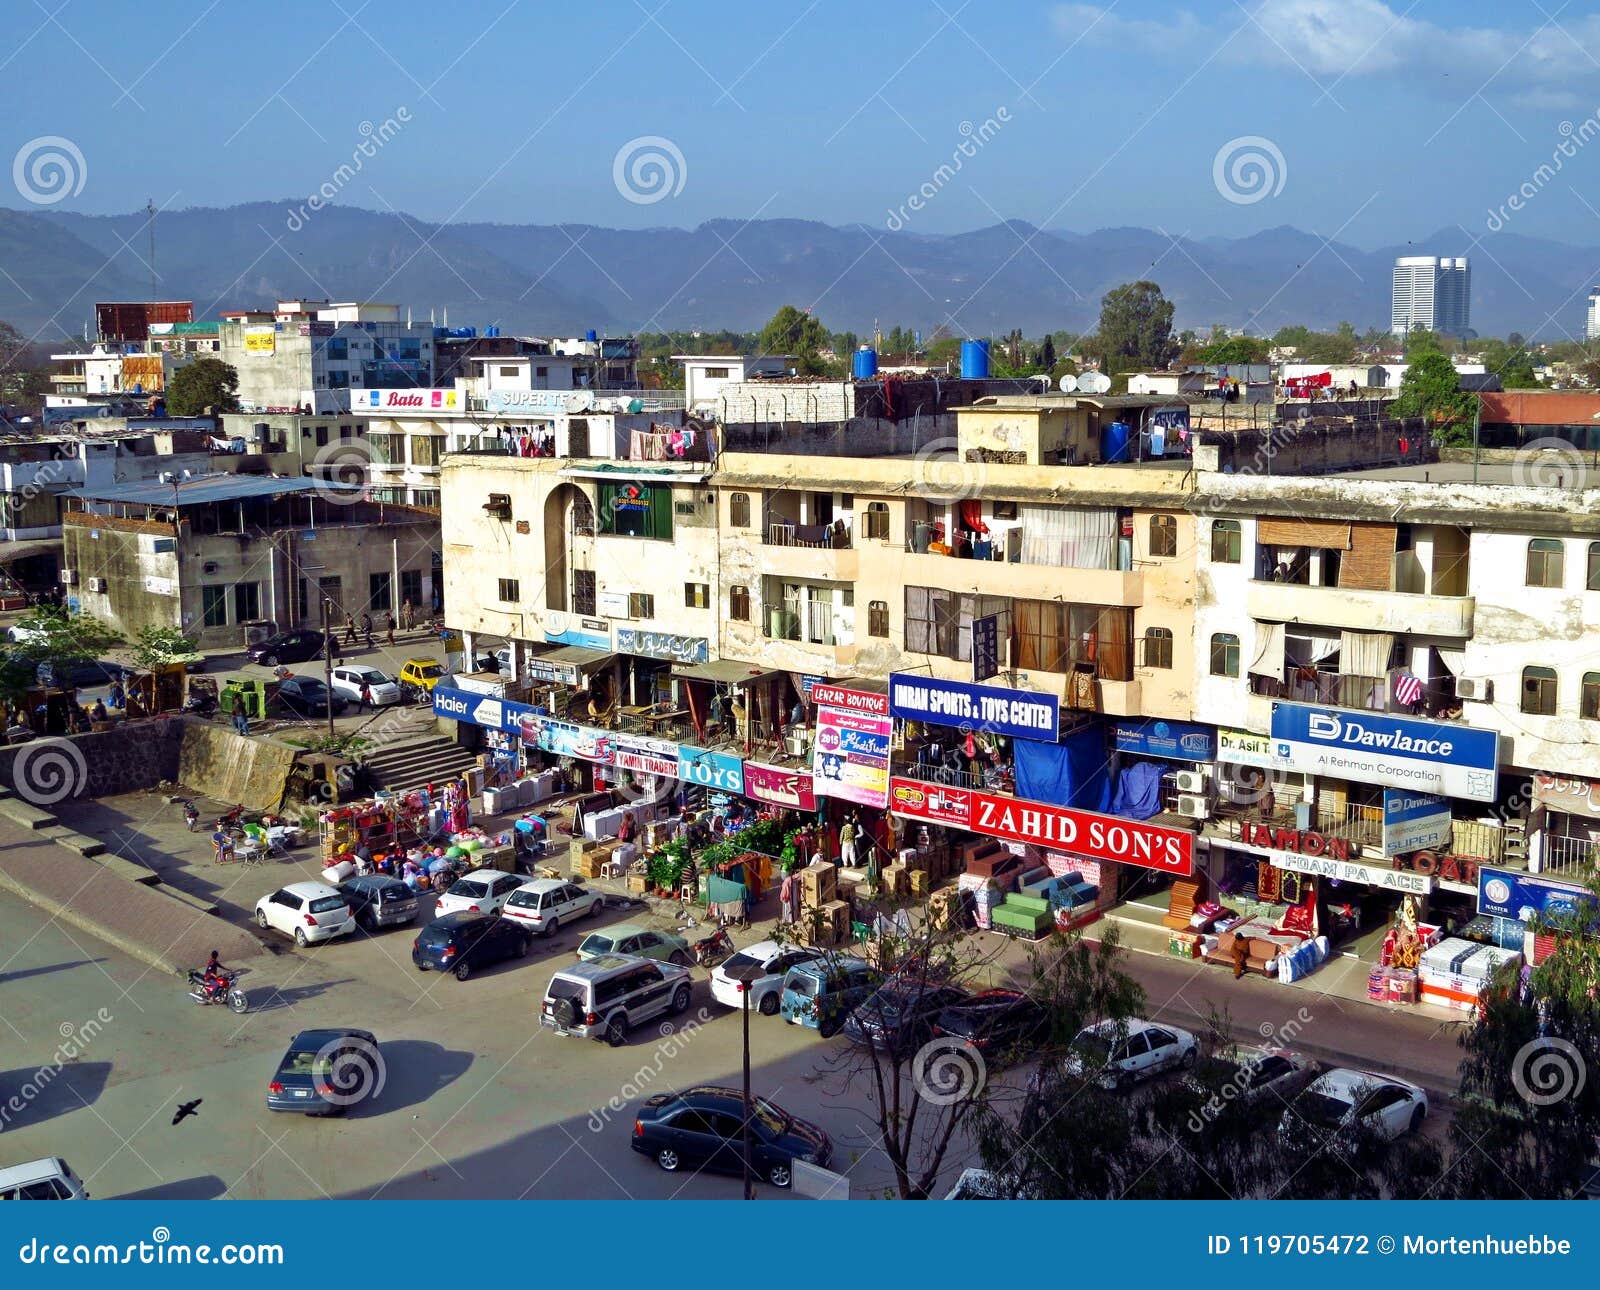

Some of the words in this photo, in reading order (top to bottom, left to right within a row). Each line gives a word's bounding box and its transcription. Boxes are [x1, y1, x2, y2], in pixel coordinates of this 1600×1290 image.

[386, 391, 424, 407] Bata
[503, 392, 547, 407] SUPER
[435, 693, 467, 714] Haier
[847, 693, 884, 711] BOUTIQUE
[895, 684, 928, 711] IMRAN
[930, 689, 972, 718] SPORTS
[973, 704, 979, 719] &
[980, 696, 1009, 724] TOYS
[1010, 700, 1053, 730] CENTER
[821, 733, 839, 744] 2015
[1221, 736, 1235, 749] Dr.
[1238, 739, 1259, 753] Asif
[1343, 722, 1453, 757] Dawlance
[619, 753, 643, 770] YAMIN
[645, 756, 678, 777] TRADERS
[680, 759, 740, 790] TOYS
[1319, 755, 1329, 765] Al
[1331, 756, 1373, 773] Rehman
[1376, 763, 1441, 782] Corporation
[980, 801, 1077, 845] ZAHID
[1090, 821, 1182, 866] SON'S
[1388, 832, 1439, 850] SUPER
[1286, 855, 1337, 878] FOAM
[1485, 904, 1508, 914] MASTER
